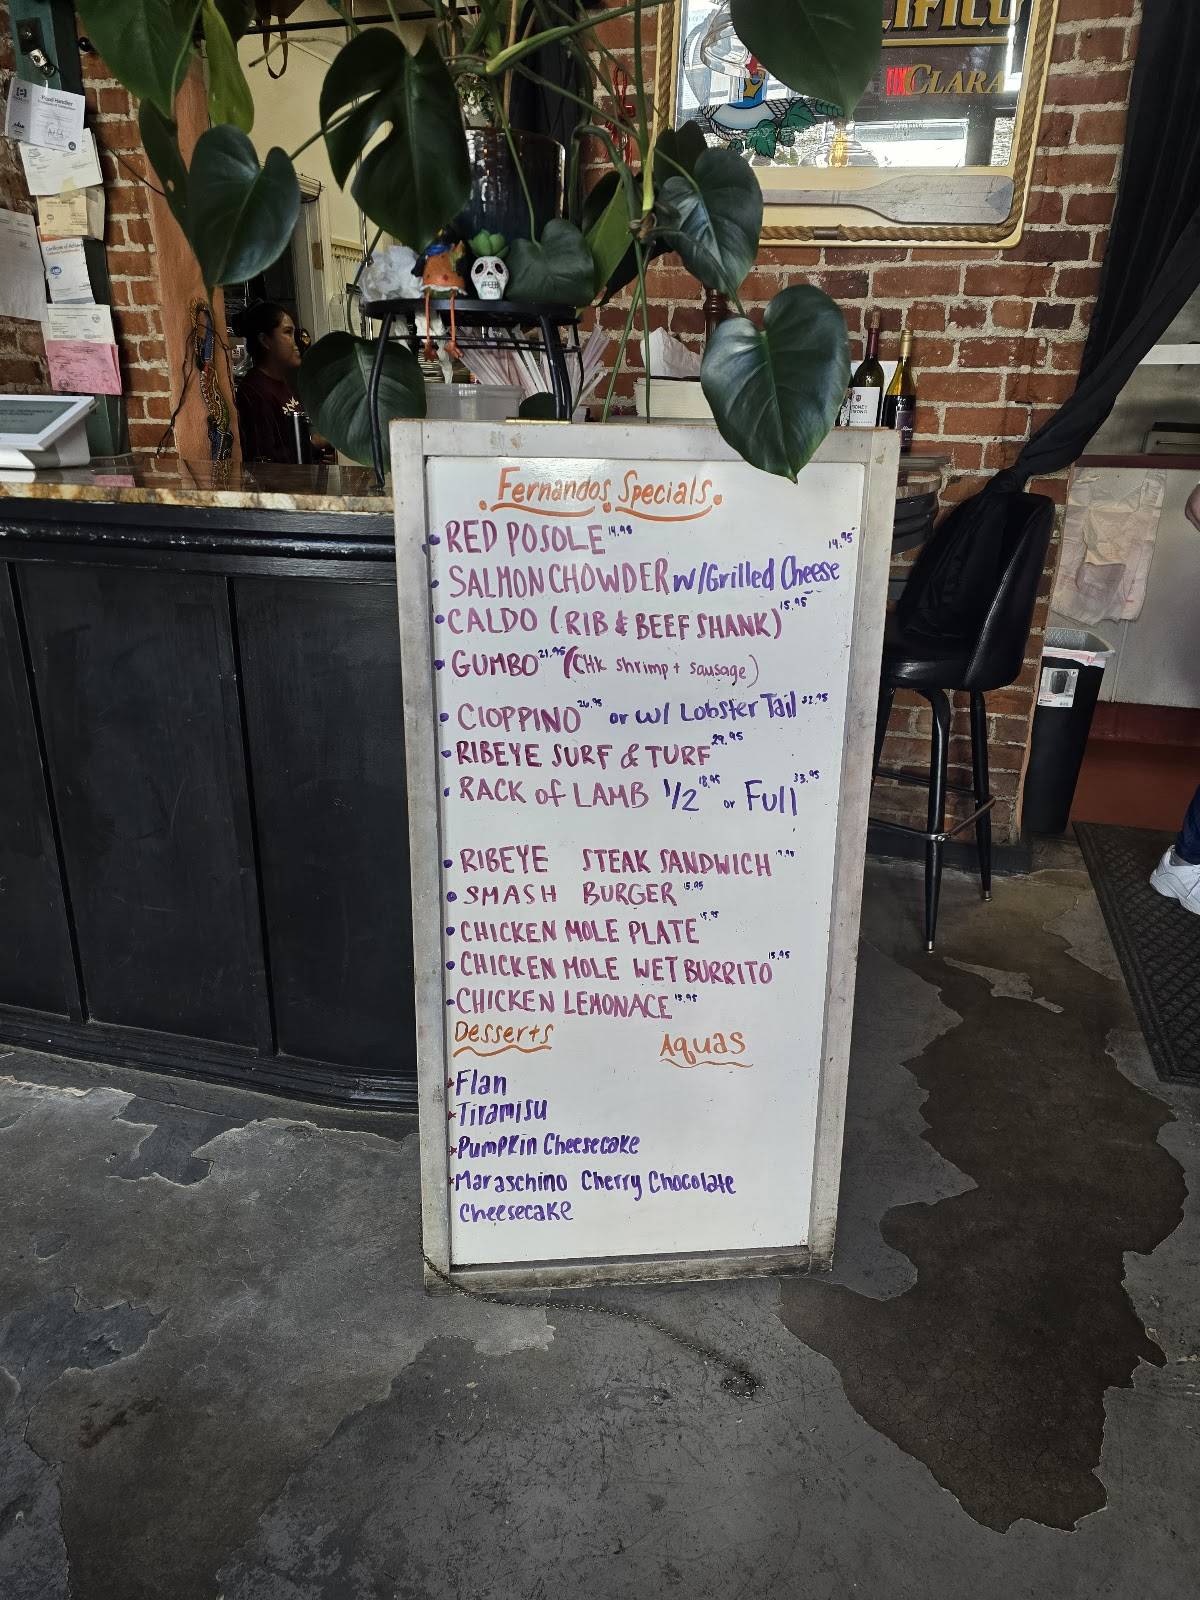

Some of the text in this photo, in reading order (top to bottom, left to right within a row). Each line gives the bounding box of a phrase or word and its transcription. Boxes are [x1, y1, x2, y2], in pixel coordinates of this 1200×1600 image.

[498, 466, 713, 509] Fernandos Specials
[445, 520, 498, 553] RED
[506, 521, 606, 557] POSOLE
[449, 565, 545, 599] SALMON
[550, 558, 670, 596] CHOWDER
[781, 555, 840, 590] Cheese
[448, 607, 538, 635] CALDO
[615, 609, 629, 637] &
[635, 612, 690, 641] BEEF
[697, 608, 782, 640] SHANK)
[452, 649, 540, 678] GUMBO
[616, 656, 669, 680] shrimp
[689, 654, 759, 689] sausage)
[457, 702, 582, 734] CIOPPINO
[609, 711, 629, 725] or
[680, 698, 759, 722] Lobster
[760, 690, 797, 719] Tail
[456, 740, 543, 768] RIBEYE
[552, 743, 613, 770] SURF
[620, 743, 640, 770] &
[645, 745, 711, 768] TURF
[459, 775, 527, 804] RACK
[535, 778, 567, 808] of
[573, 781, 649, 809] LAMB
[664, 778, 699, 812] 1/2
[723, 799, 736, 809] or
[744, 779, 798, 817] Full
[459, 844, 549, 874] RIBEYE
[582, 848, 651, 873] STEAK
[659, 848, 772, 877] SANDWICH
[463, 883, 557, 906] SMASH
[582, 881, 678, 907] BURGER
[460, 919, 558, 944] CHICKEN
[564, 918, 620, 943] MOLE
[628, 917, 699, 946] PLATE
[460, 951, 558, 980] CHICKEN
[562, 955, 620, 981] MOLE
[633, 956, 678, 983] WET
[684, 958, 773, 985] BURRITO
[456, 986, 556, 1014] CHICKEN
[454, 1020, 554, 1044] Desserts
[455, 1068, 507, 1097] Flan
[456, 1098, 548, 1127] Tiramisu
[455, 1169, 737, 1202] Maraschino Cherry Chocolate
